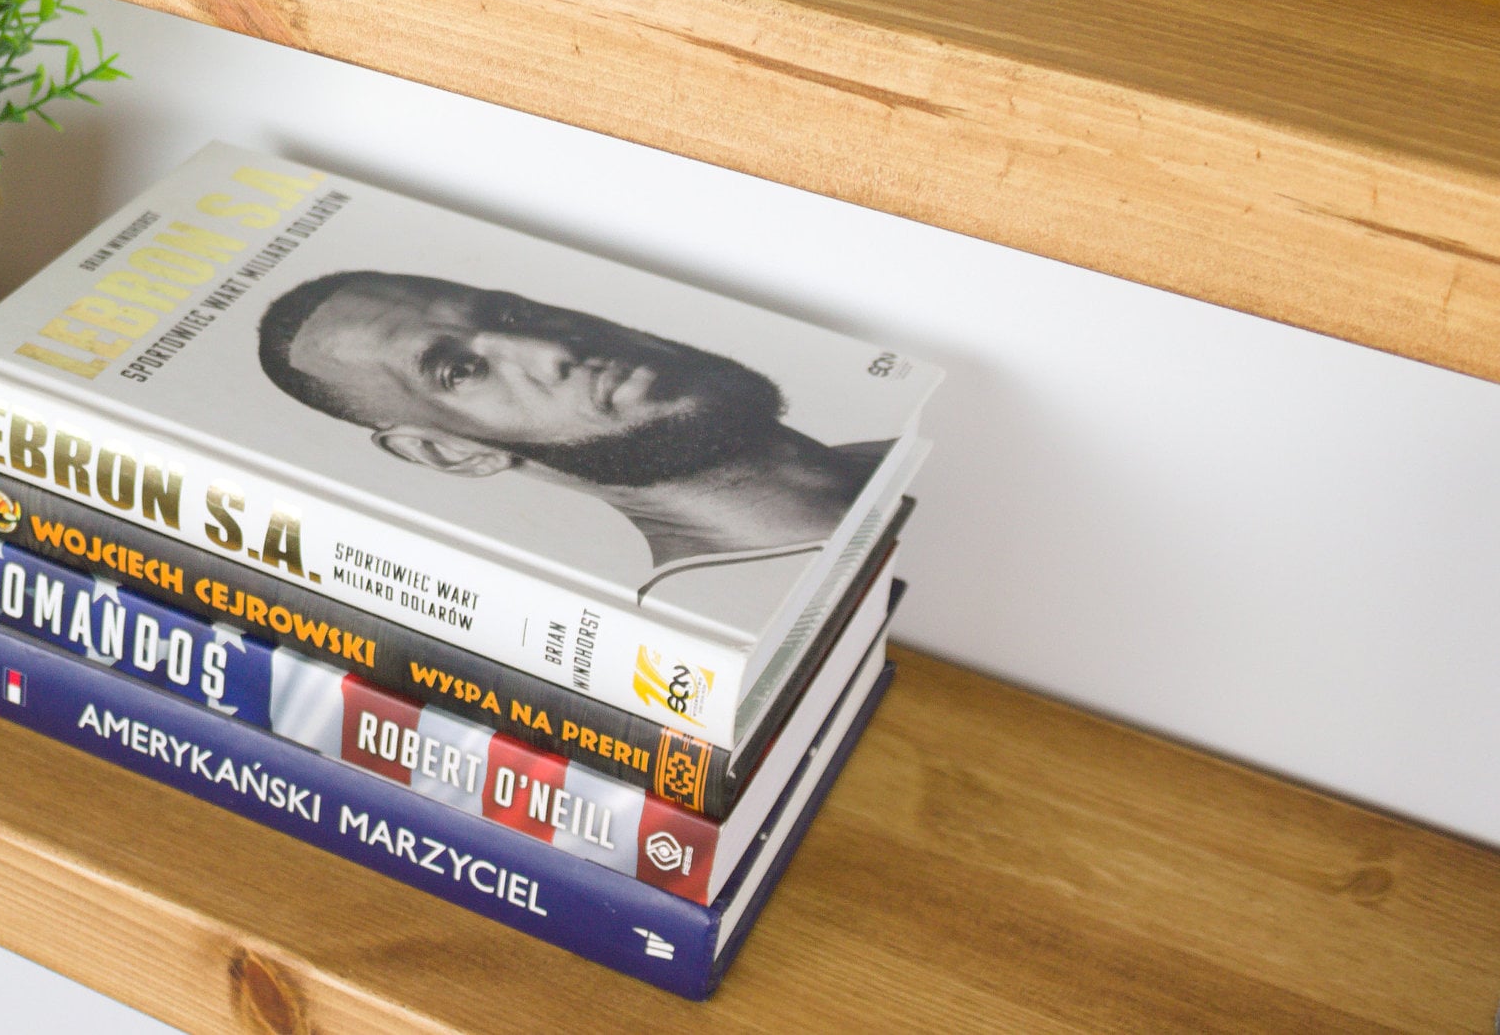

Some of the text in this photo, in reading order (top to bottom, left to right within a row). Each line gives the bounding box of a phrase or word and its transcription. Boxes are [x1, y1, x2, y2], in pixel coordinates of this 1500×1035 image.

[14, 166, 328, 381] LEBRON S.A.
[79, 248, 114, 272] BRIAN
[120, 188, 353, 384] SPORTOWIEC WART MILIARD DOLARÓW
[204, 477, 322, 585] S.A.
[333, 541, 481, 611] SPORTOWIEC WART
[30, 515, 377, 669] WOJCIECH CEJROWSKI
[332, 565, 474, 632] MILIARD DOLARÓW
[545, 621, 567, 666] BRIAN
[573, 607, 602, 692] WINDHORST
[409, 661, 650, 773] WYSPA NA PRERII
[77, 703, 548, 917] AMERYKAŃSKI MARZYCIEL
[356, 711, 615, 850] ROBERT O'NEILL
